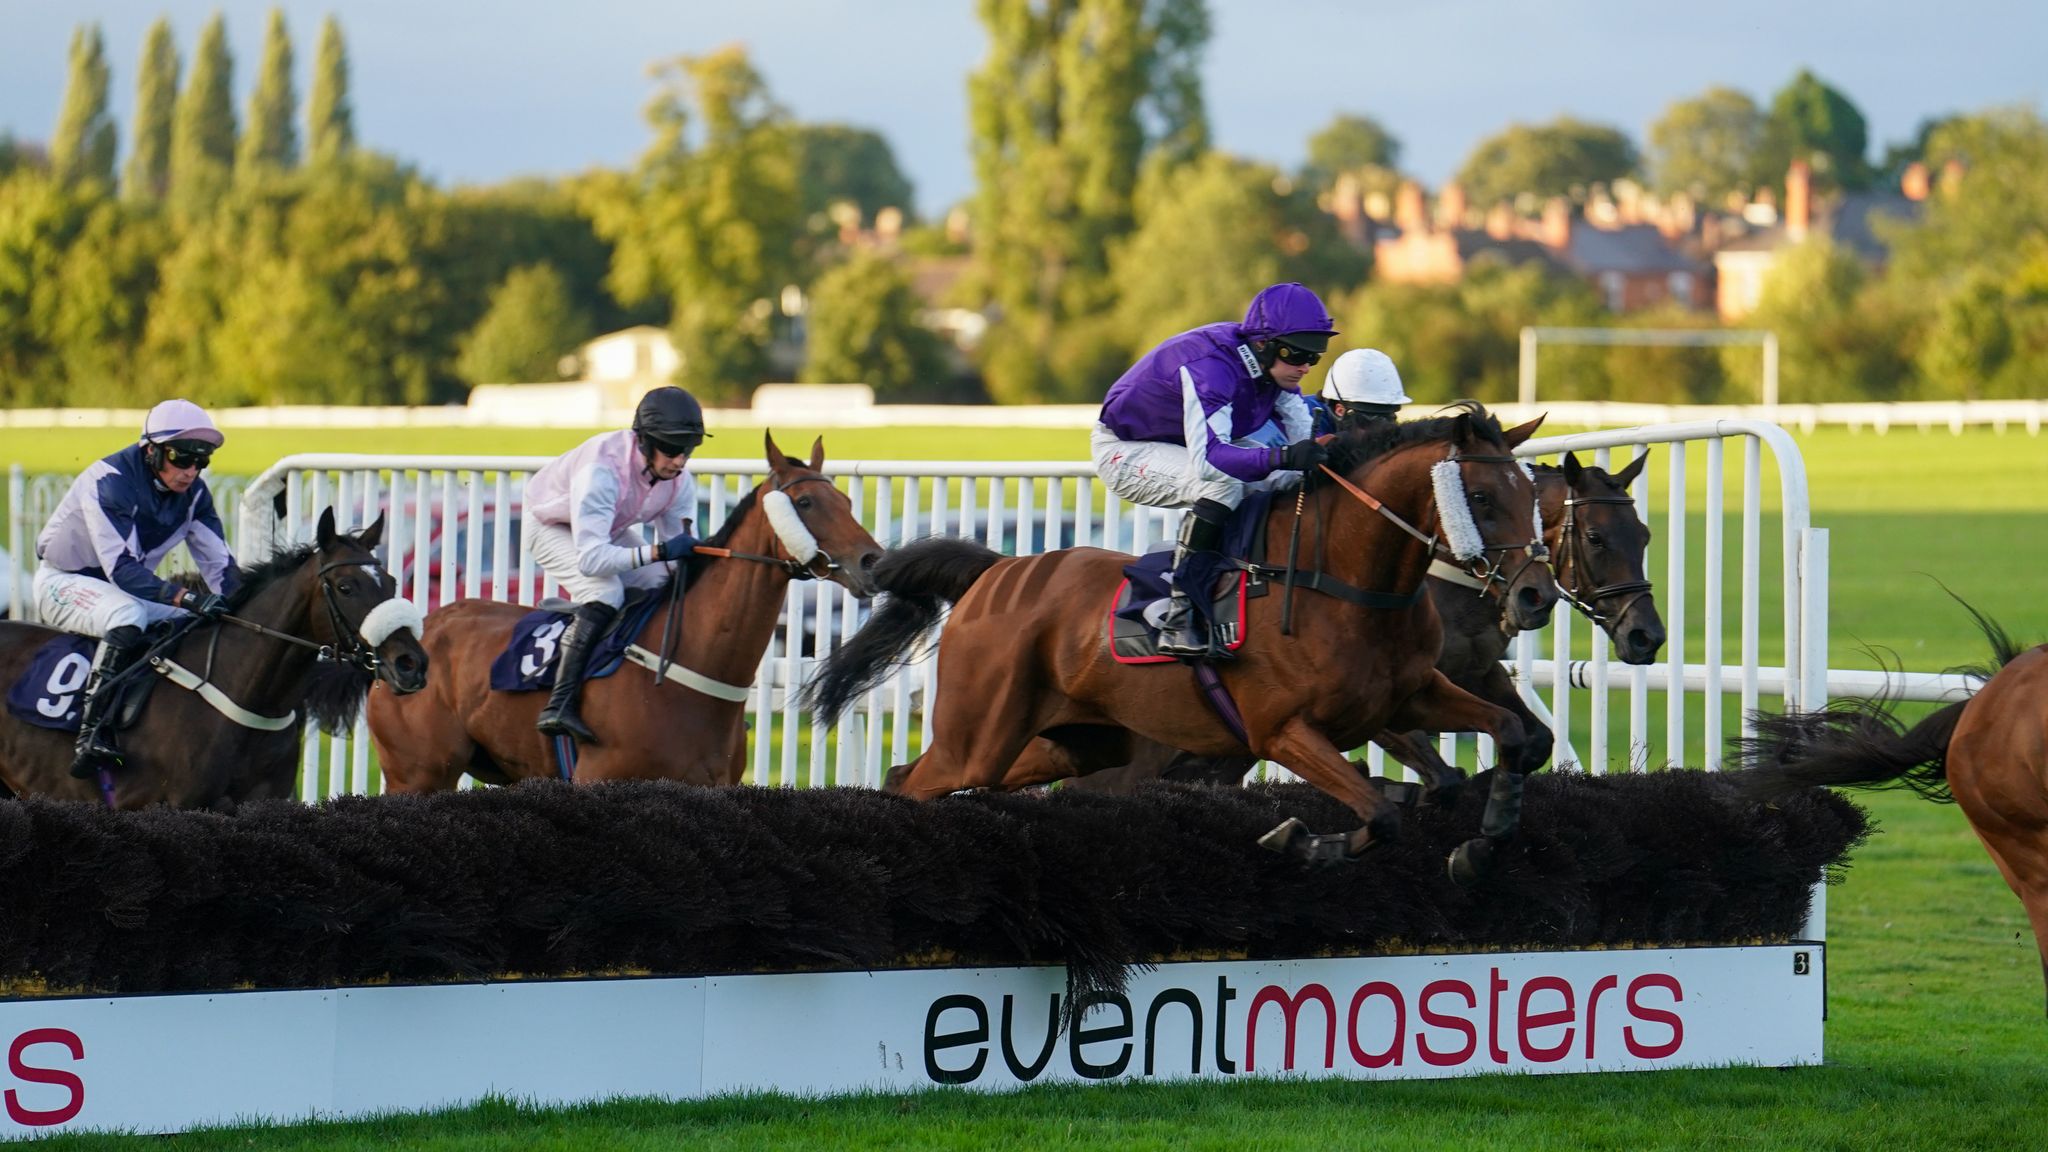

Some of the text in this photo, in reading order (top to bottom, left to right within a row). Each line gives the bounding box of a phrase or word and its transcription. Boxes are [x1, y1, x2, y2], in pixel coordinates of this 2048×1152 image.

[521, 620, 566, 677] 3
[1795, 953, 1806, 974] 3
[924, 968, 1684, 1085] eventmasters
